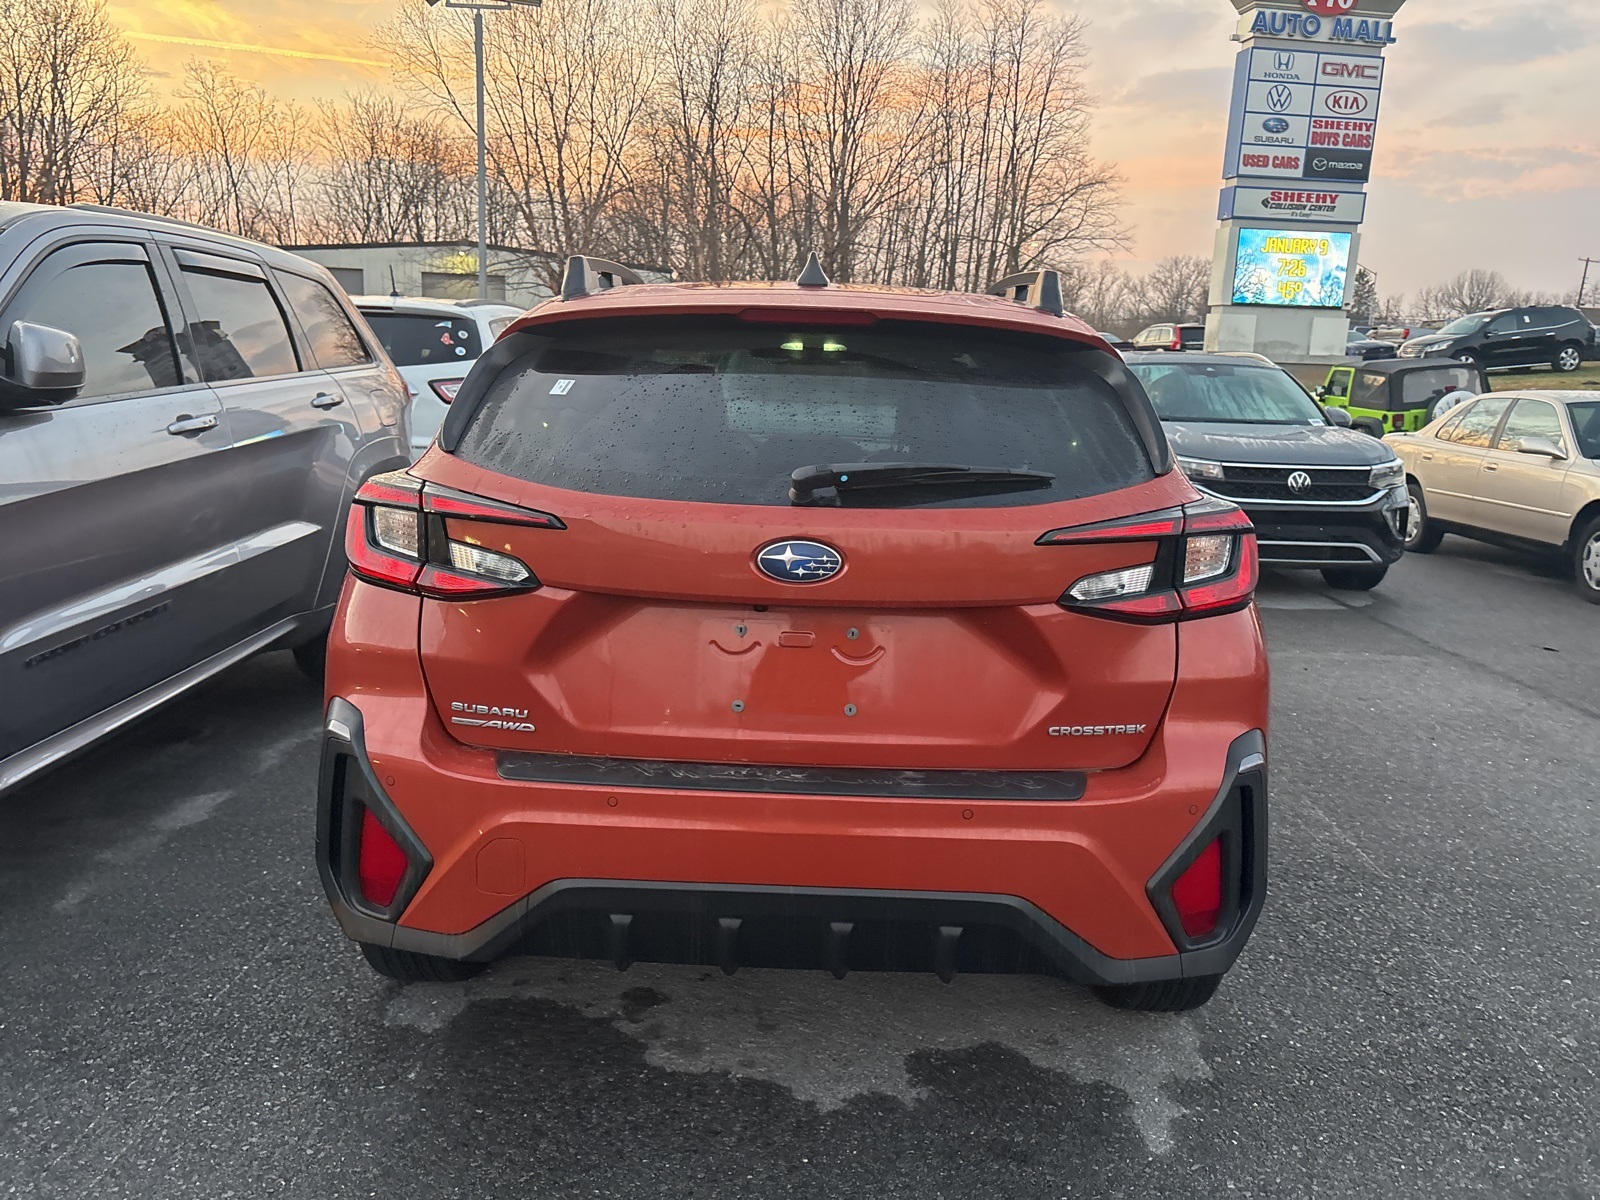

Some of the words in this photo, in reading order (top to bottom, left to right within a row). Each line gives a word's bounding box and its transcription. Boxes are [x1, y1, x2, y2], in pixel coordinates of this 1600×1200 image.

[1250, 10, 1321, 37] AUTO
[1332, 17, 1397, 43] MALL
[1263, 72, 1300, 80] HONDA
[1321, 62, 1379, 80] GMC
[1332, 95, 1360, 110] KIA
[1312, 119, 1373, 132] SHEEHY
[1254, 136, 1294, 144] SUBARU
[1311, 131, 1340, 146] BUYS
[1342, 133, 1372, 148] CARS
[1242, 153, 1270, 168] USED
[1271, 155, 1300, 170] CARS
[1269, 191, 1339, 204] SHEEHY
[1269, 203, 1308, 211] COLLISION
[1261, 237, 1318, 255] JANUARY
[1319, 239, 1329, 256] 9
[1277, 258, 1307, 278] 7:26
[451, 701, 529, 718] SUBARU
[482, 720, 536, 732] AWD
[1048, 724, 1147, 737] CROSSTREK
